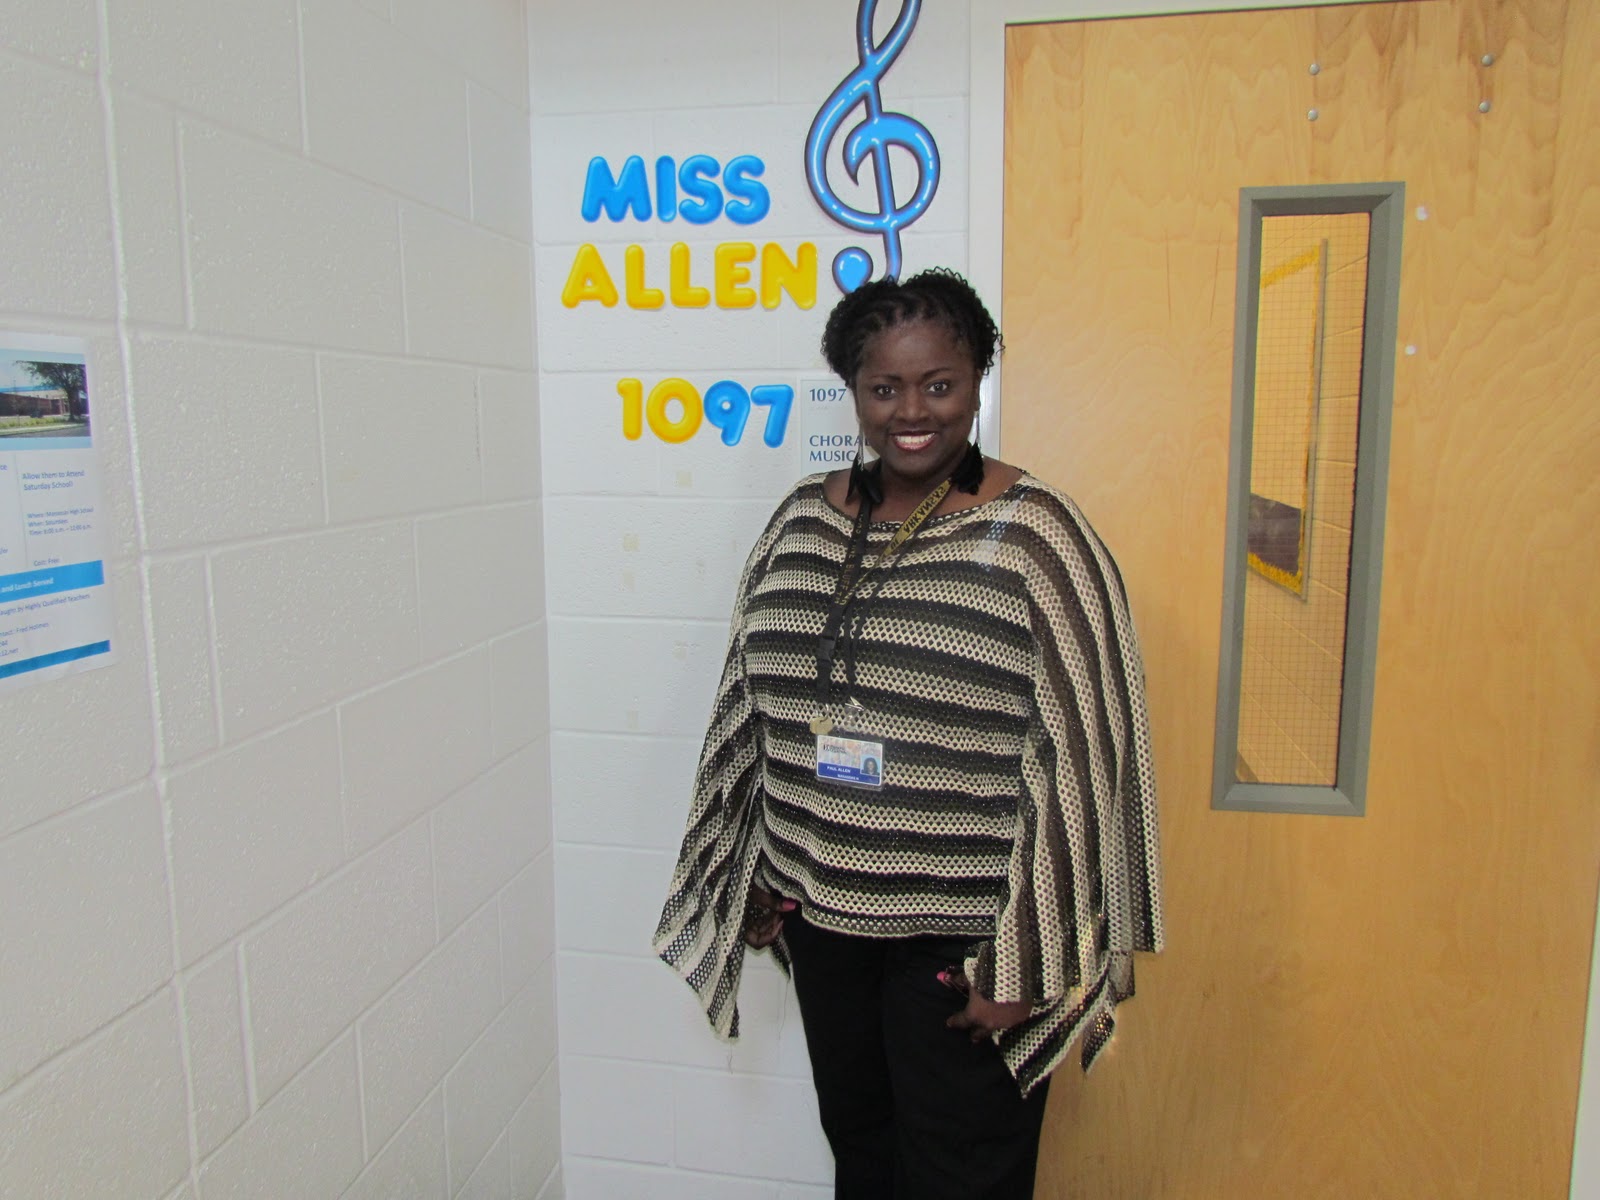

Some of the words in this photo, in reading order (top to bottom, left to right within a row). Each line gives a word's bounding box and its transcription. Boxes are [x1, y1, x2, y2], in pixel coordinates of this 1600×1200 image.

[581, 154, 771, 225] MISS
[561, 241, 818, 310] ALLEN
[616, 377, 794, 448] 1097
[809, 388, 847, 402] 1097
[809, 450, 856, 462] MUSIC
[24, 483, 51, 491] Saturday
